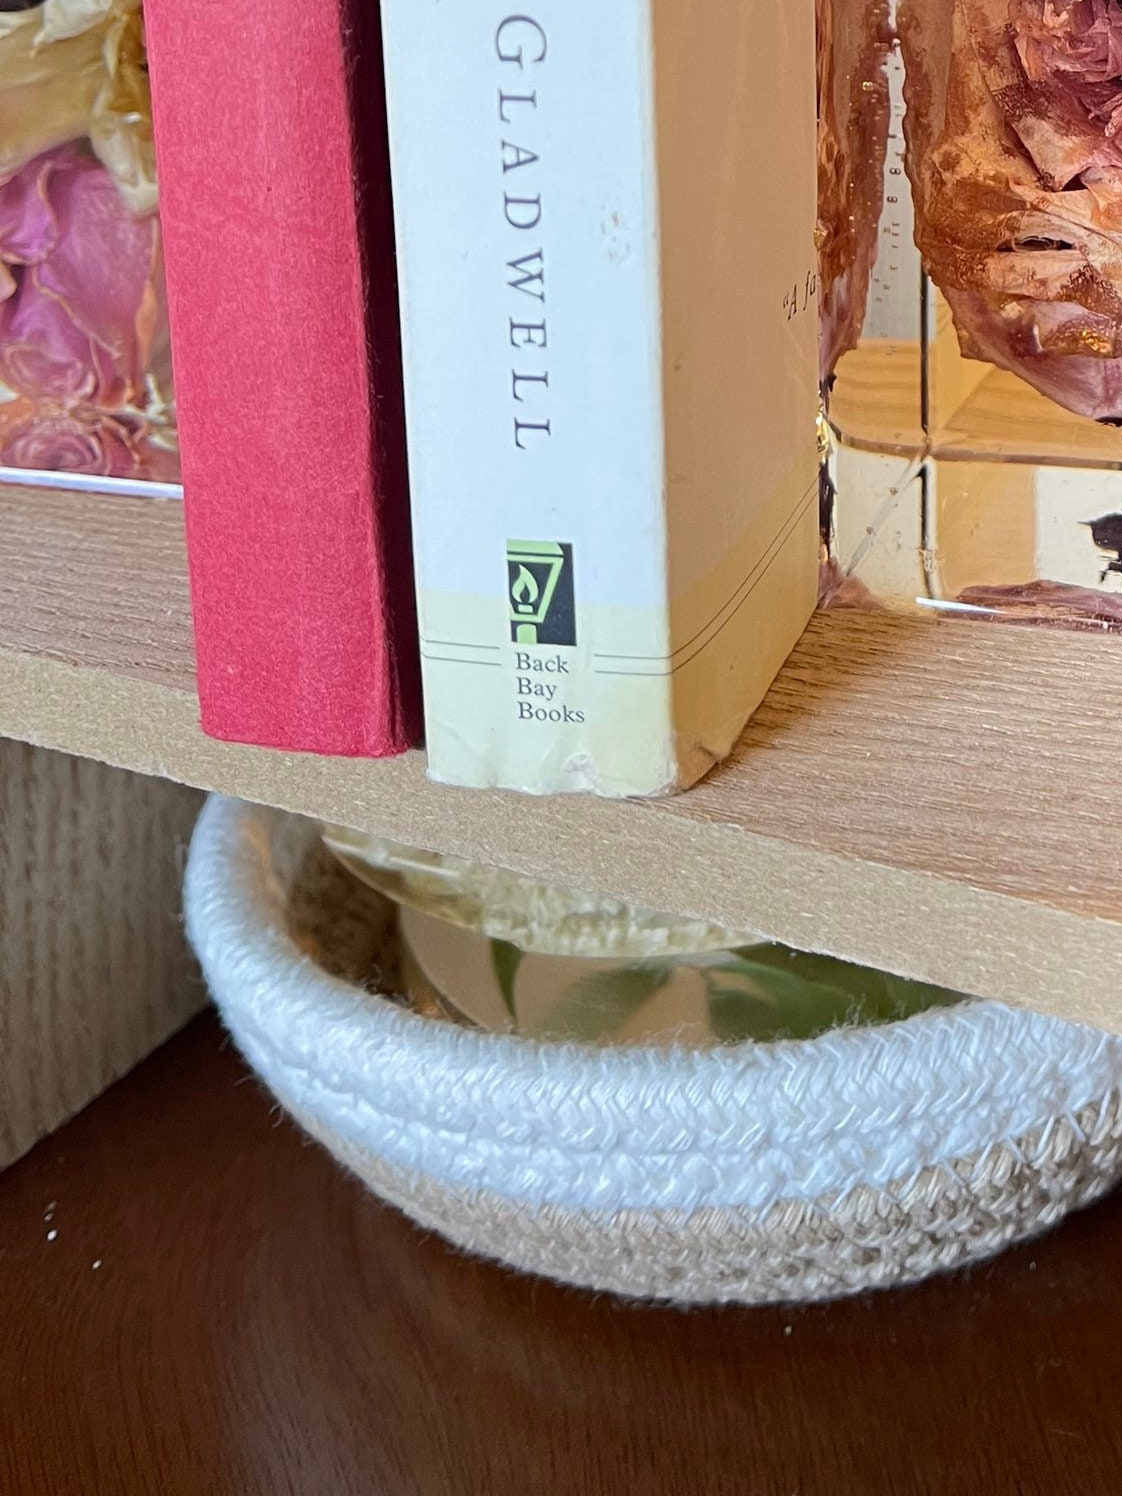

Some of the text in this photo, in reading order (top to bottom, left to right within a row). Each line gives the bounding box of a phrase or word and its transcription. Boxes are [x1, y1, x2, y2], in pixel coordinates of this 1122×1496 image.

[493, 14, 552, 451] GLADWELL
[515, 652, 569, 674] Back
[516, 676, 557, 701] Bay
[517, 701, 585, 723] Books
